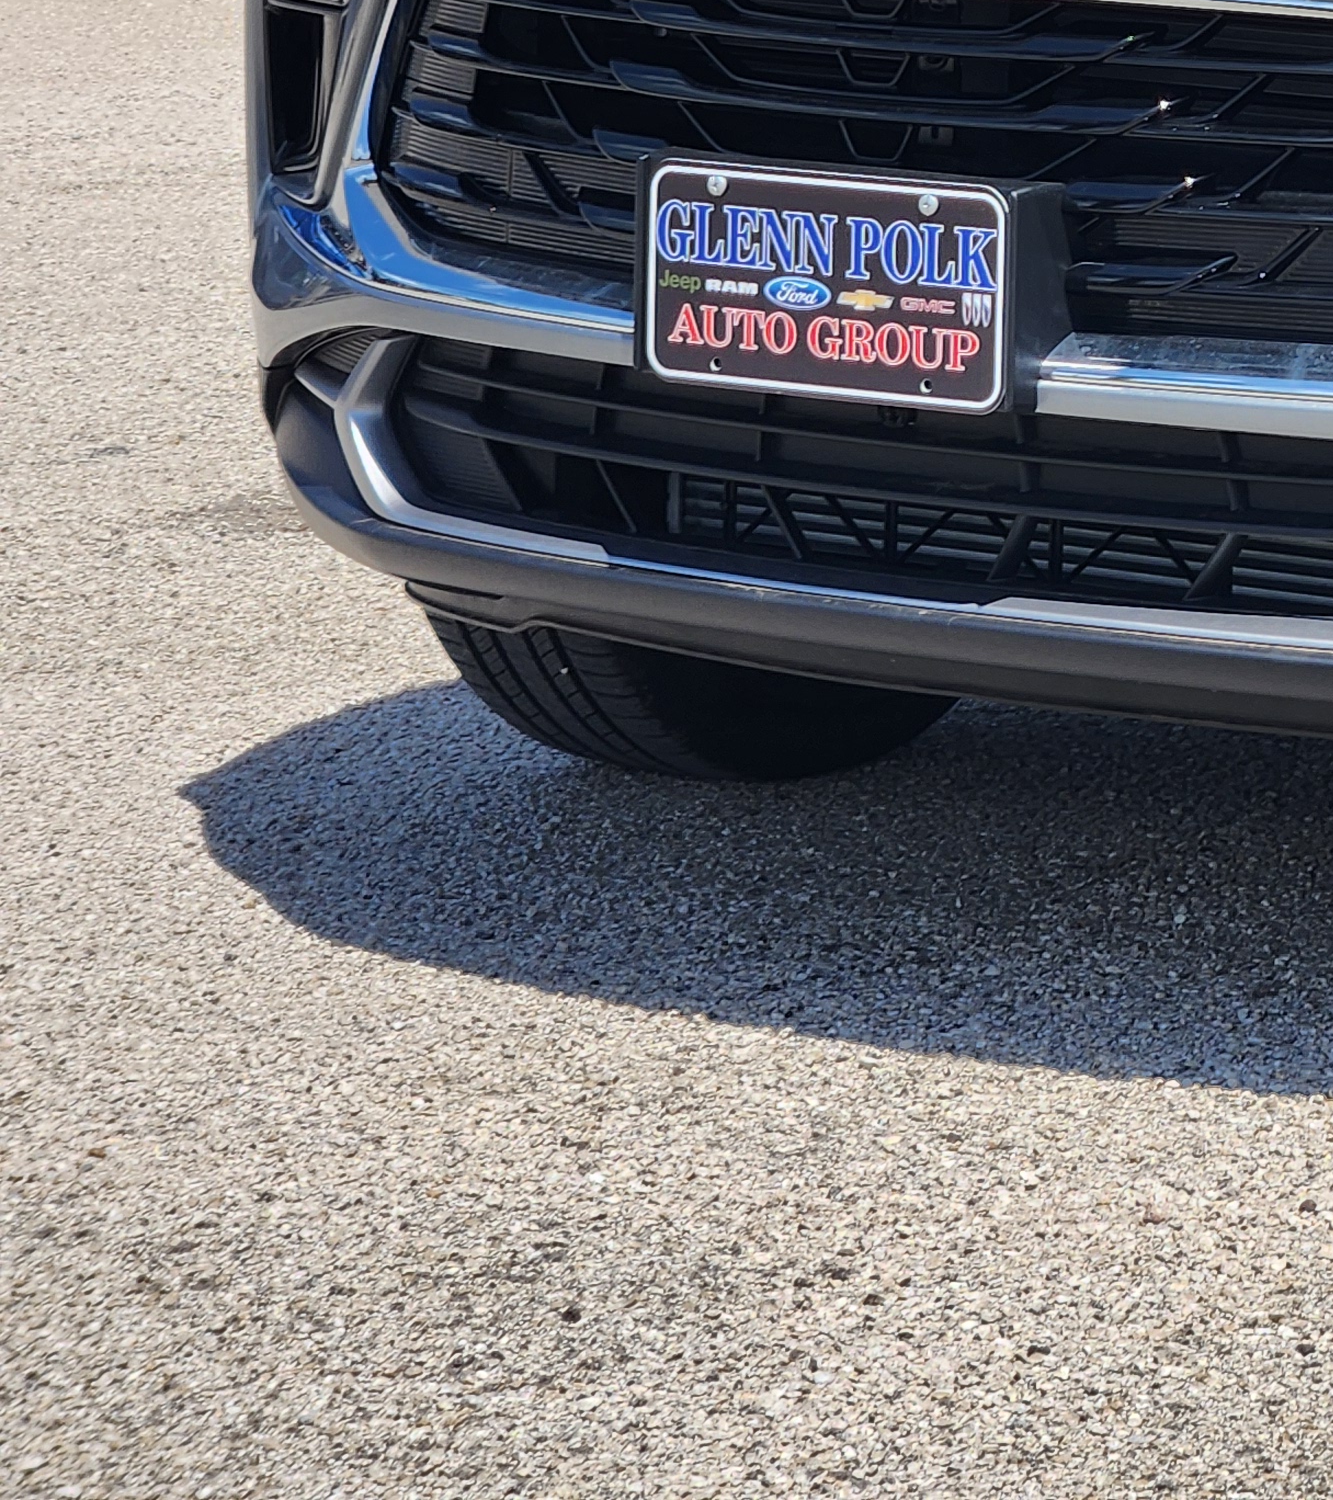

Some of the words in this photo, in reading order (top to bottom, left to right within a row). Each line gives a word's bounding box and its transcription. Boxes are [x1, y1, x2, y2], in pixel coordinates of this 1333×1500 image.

[656, 198, 839, 277] GLENN
[845, 217, 998, 291] POLK
[659, 269, 702, 294] Jeep
[704, 279, 759, 297] RAM
[776, 283, 819, 307] Ford
[900, 297, 956, 315] GMC
[667, 302, 798, 355] AUTO
[806, 316, 980, 373] GROUP
